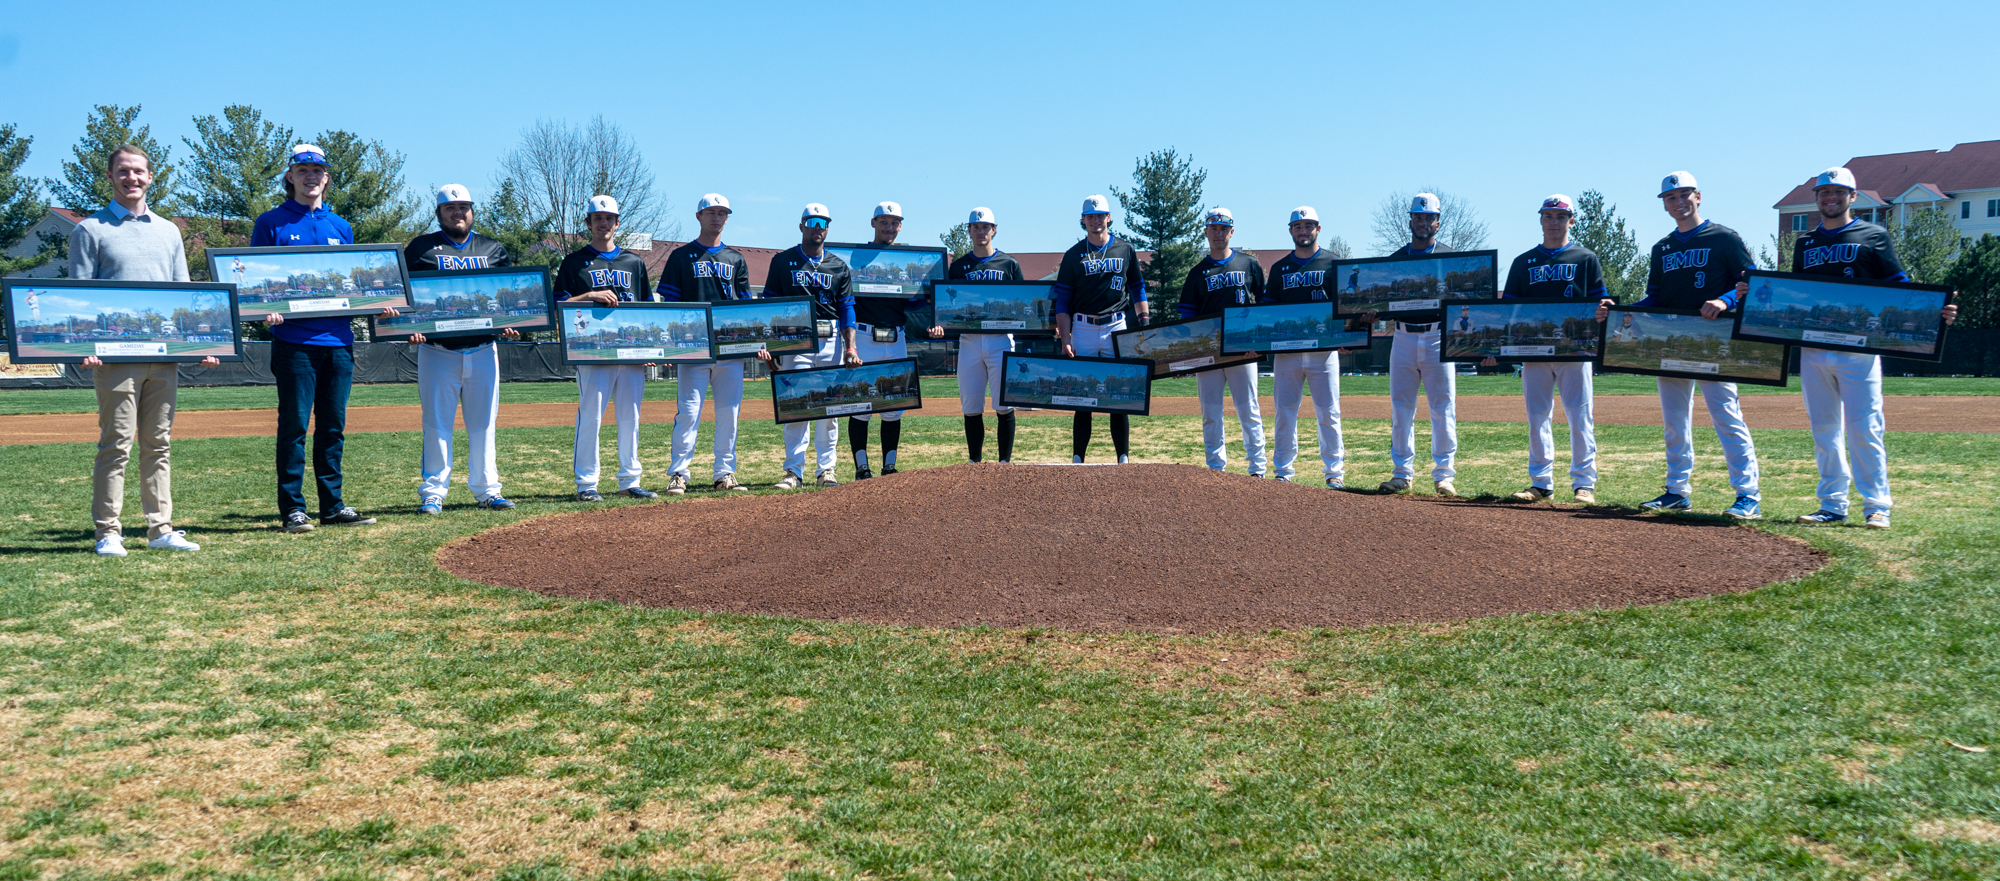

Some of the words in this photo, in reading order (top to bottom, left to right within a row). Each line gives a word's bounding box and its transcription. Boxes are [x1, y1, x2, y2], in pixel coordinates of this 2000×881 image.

[1662, 249, 1712, 272] EMU
[1803, 243, 1862, 268] EMU
[692, 262, 734, 279] EMU
[1083, 258, 1124, 275] EMU
[1528, 264, 1578, 284] EMU
[588, 269, 632, 288] EMU
[791, 271, 834, 289] EMU
[1110, 275, 1122, 291] 17
[1205, 271, 1246, 291] EMU
[1282, 271, 1326, 290] EMU
[1694, 271, 1706, 289] 3
[1311, 289, 1325, 301] 10
[1563, 284, 1573, 297] 4
